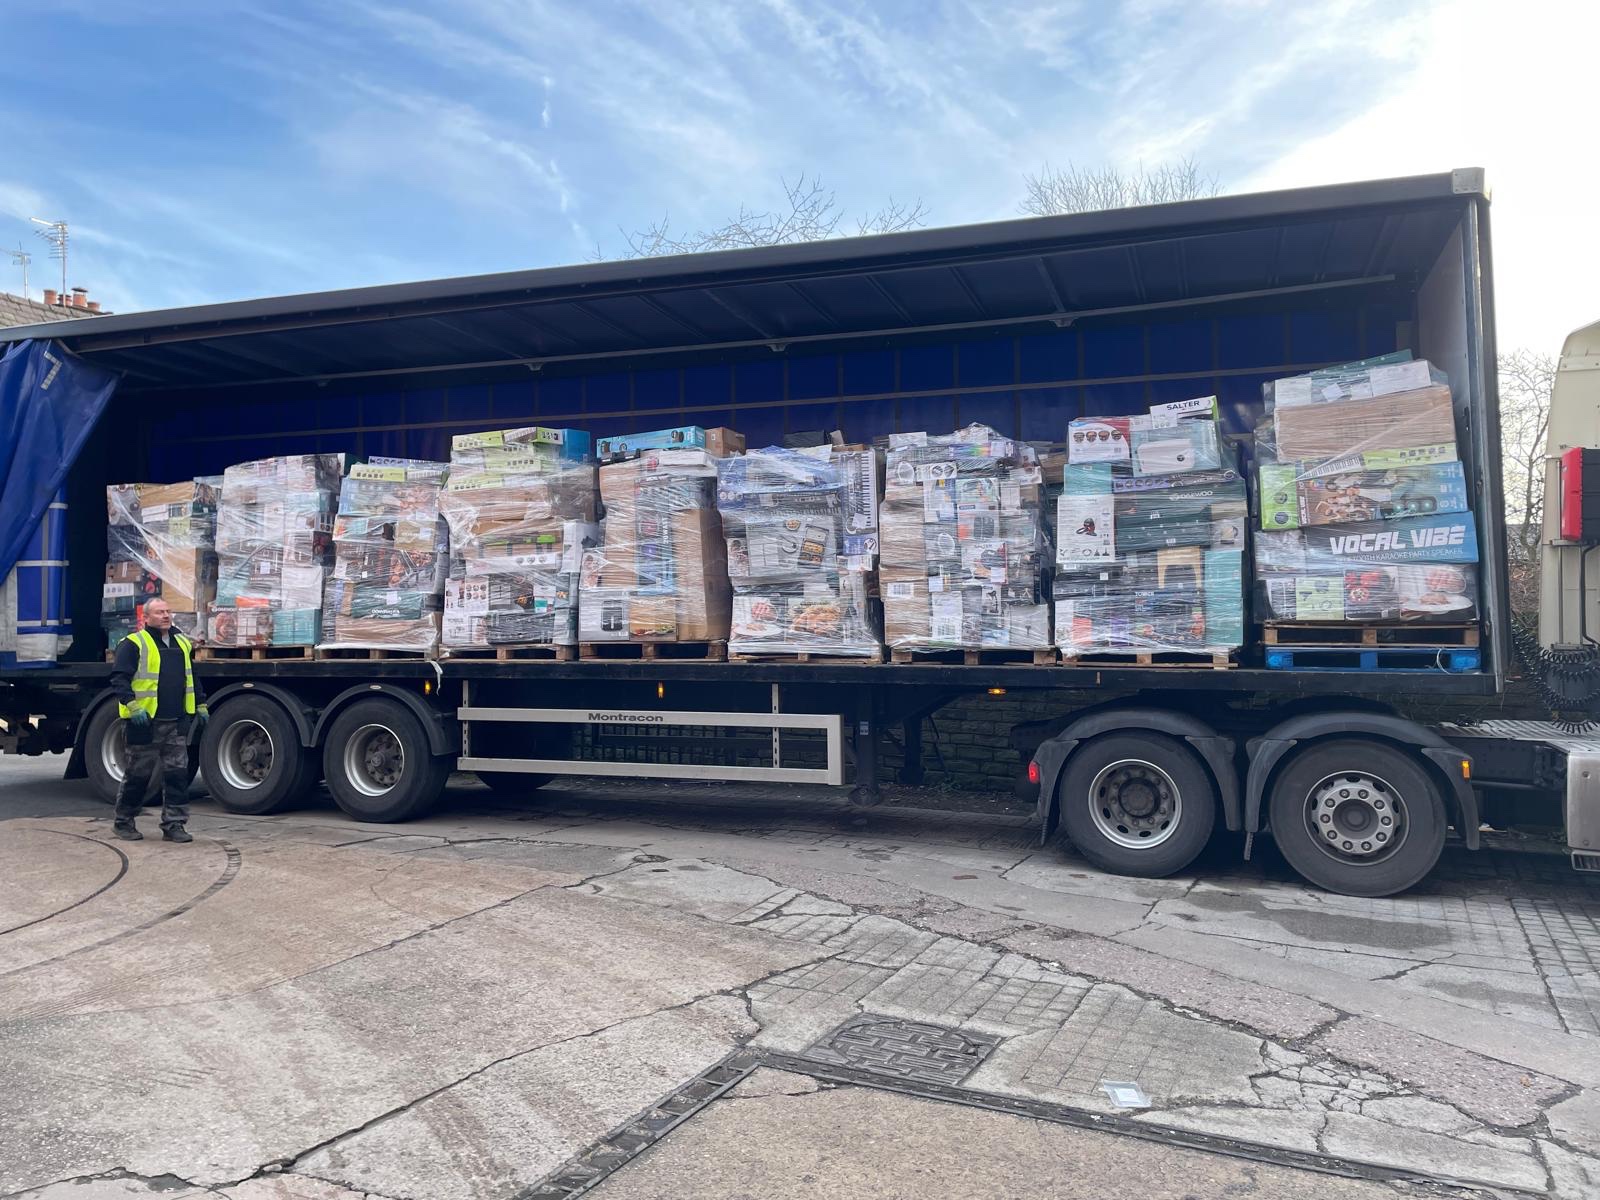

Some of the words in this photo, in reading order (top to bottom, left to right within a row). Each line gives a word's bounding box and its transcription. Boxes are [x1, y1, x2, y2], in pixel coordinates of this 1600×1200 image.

[1166, 400, 1200, 411] SALTER
[1329, 531, 1407, 555] VOCAL
[1409, 525, 1466, 549] VIBE
[1376, 551, 1407, 560] KARAOKE
[1407, 549, 1430, 558] PARTY
[1431, 547, 1463, 557] SPEAKER
[588, 712, 664, 722] Montracon
